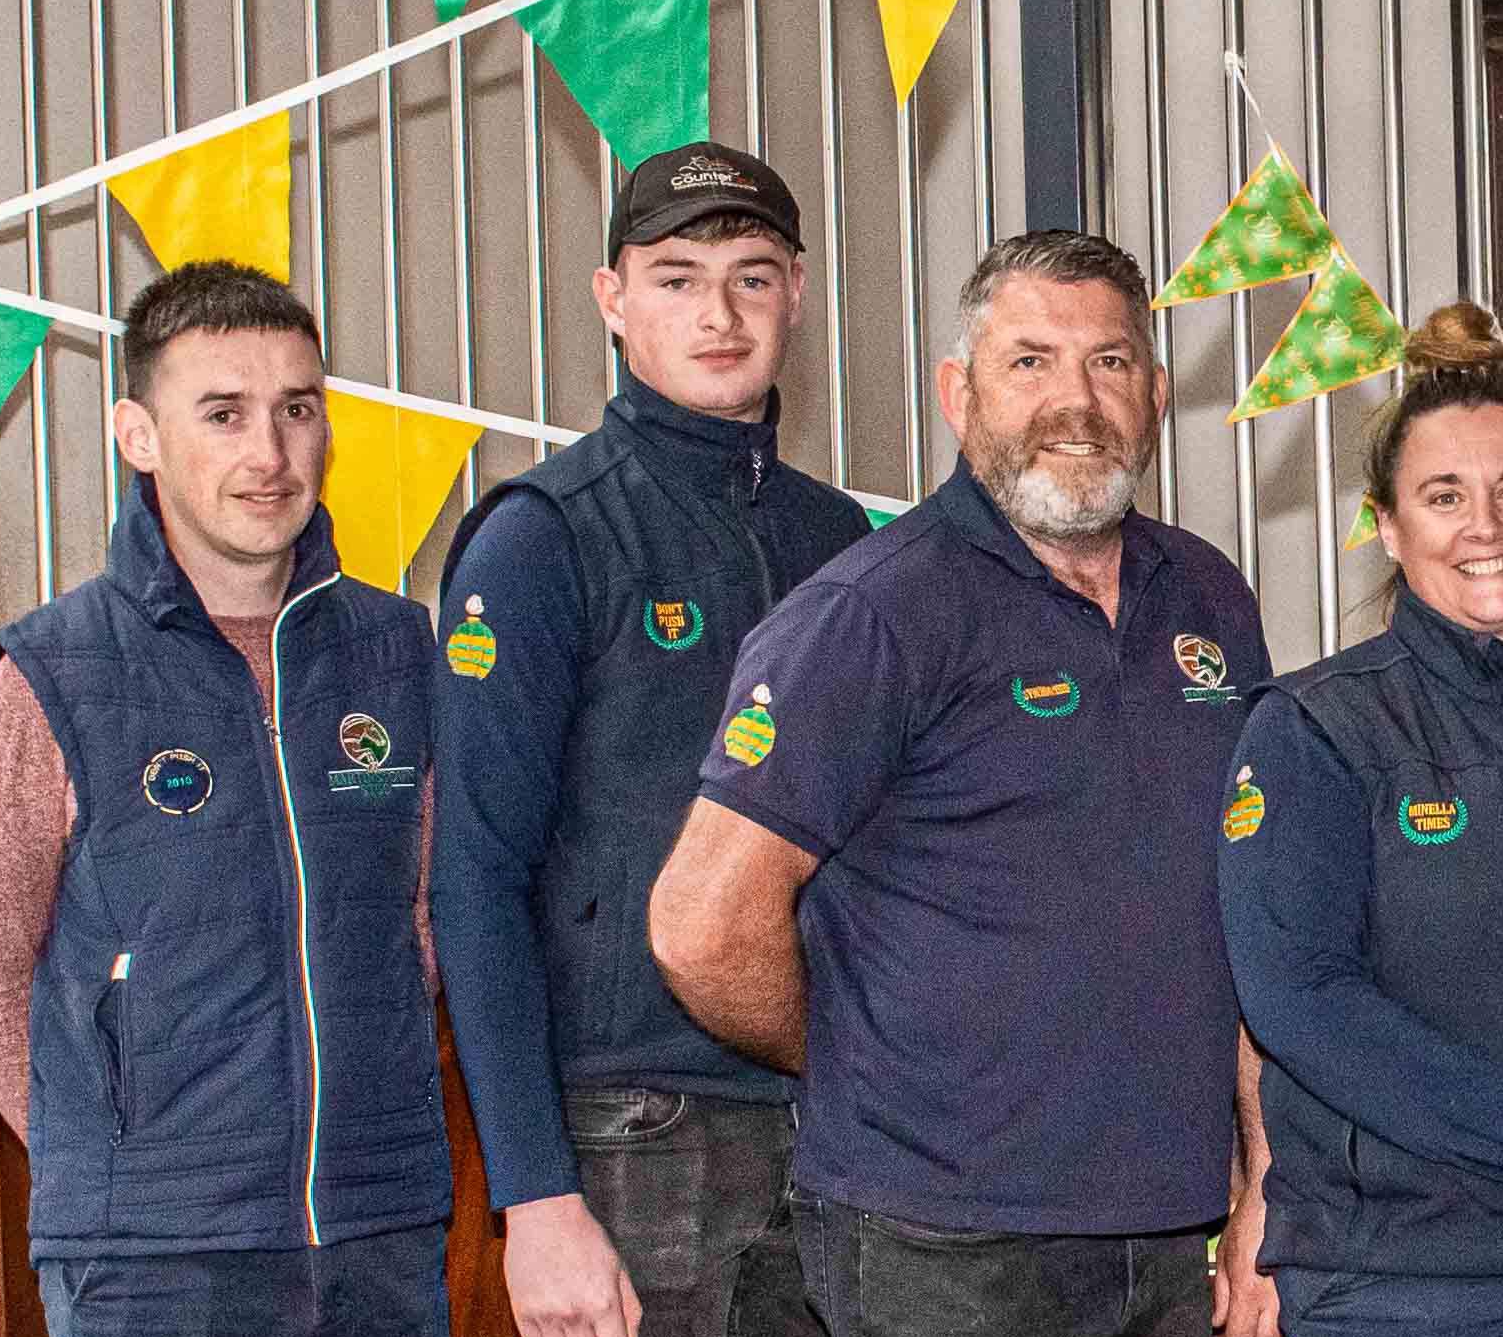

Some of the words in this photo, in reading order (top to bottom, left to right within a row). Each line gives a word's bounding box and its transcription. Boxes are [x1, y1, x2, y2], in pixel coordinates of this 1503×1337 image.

[658, 614, 686, 628] PUSH
[667, 628, 679, 640] IT
[1408, 802, 1457, 817] MINELLA
[1414, 816, 1451, 831] TIMES
